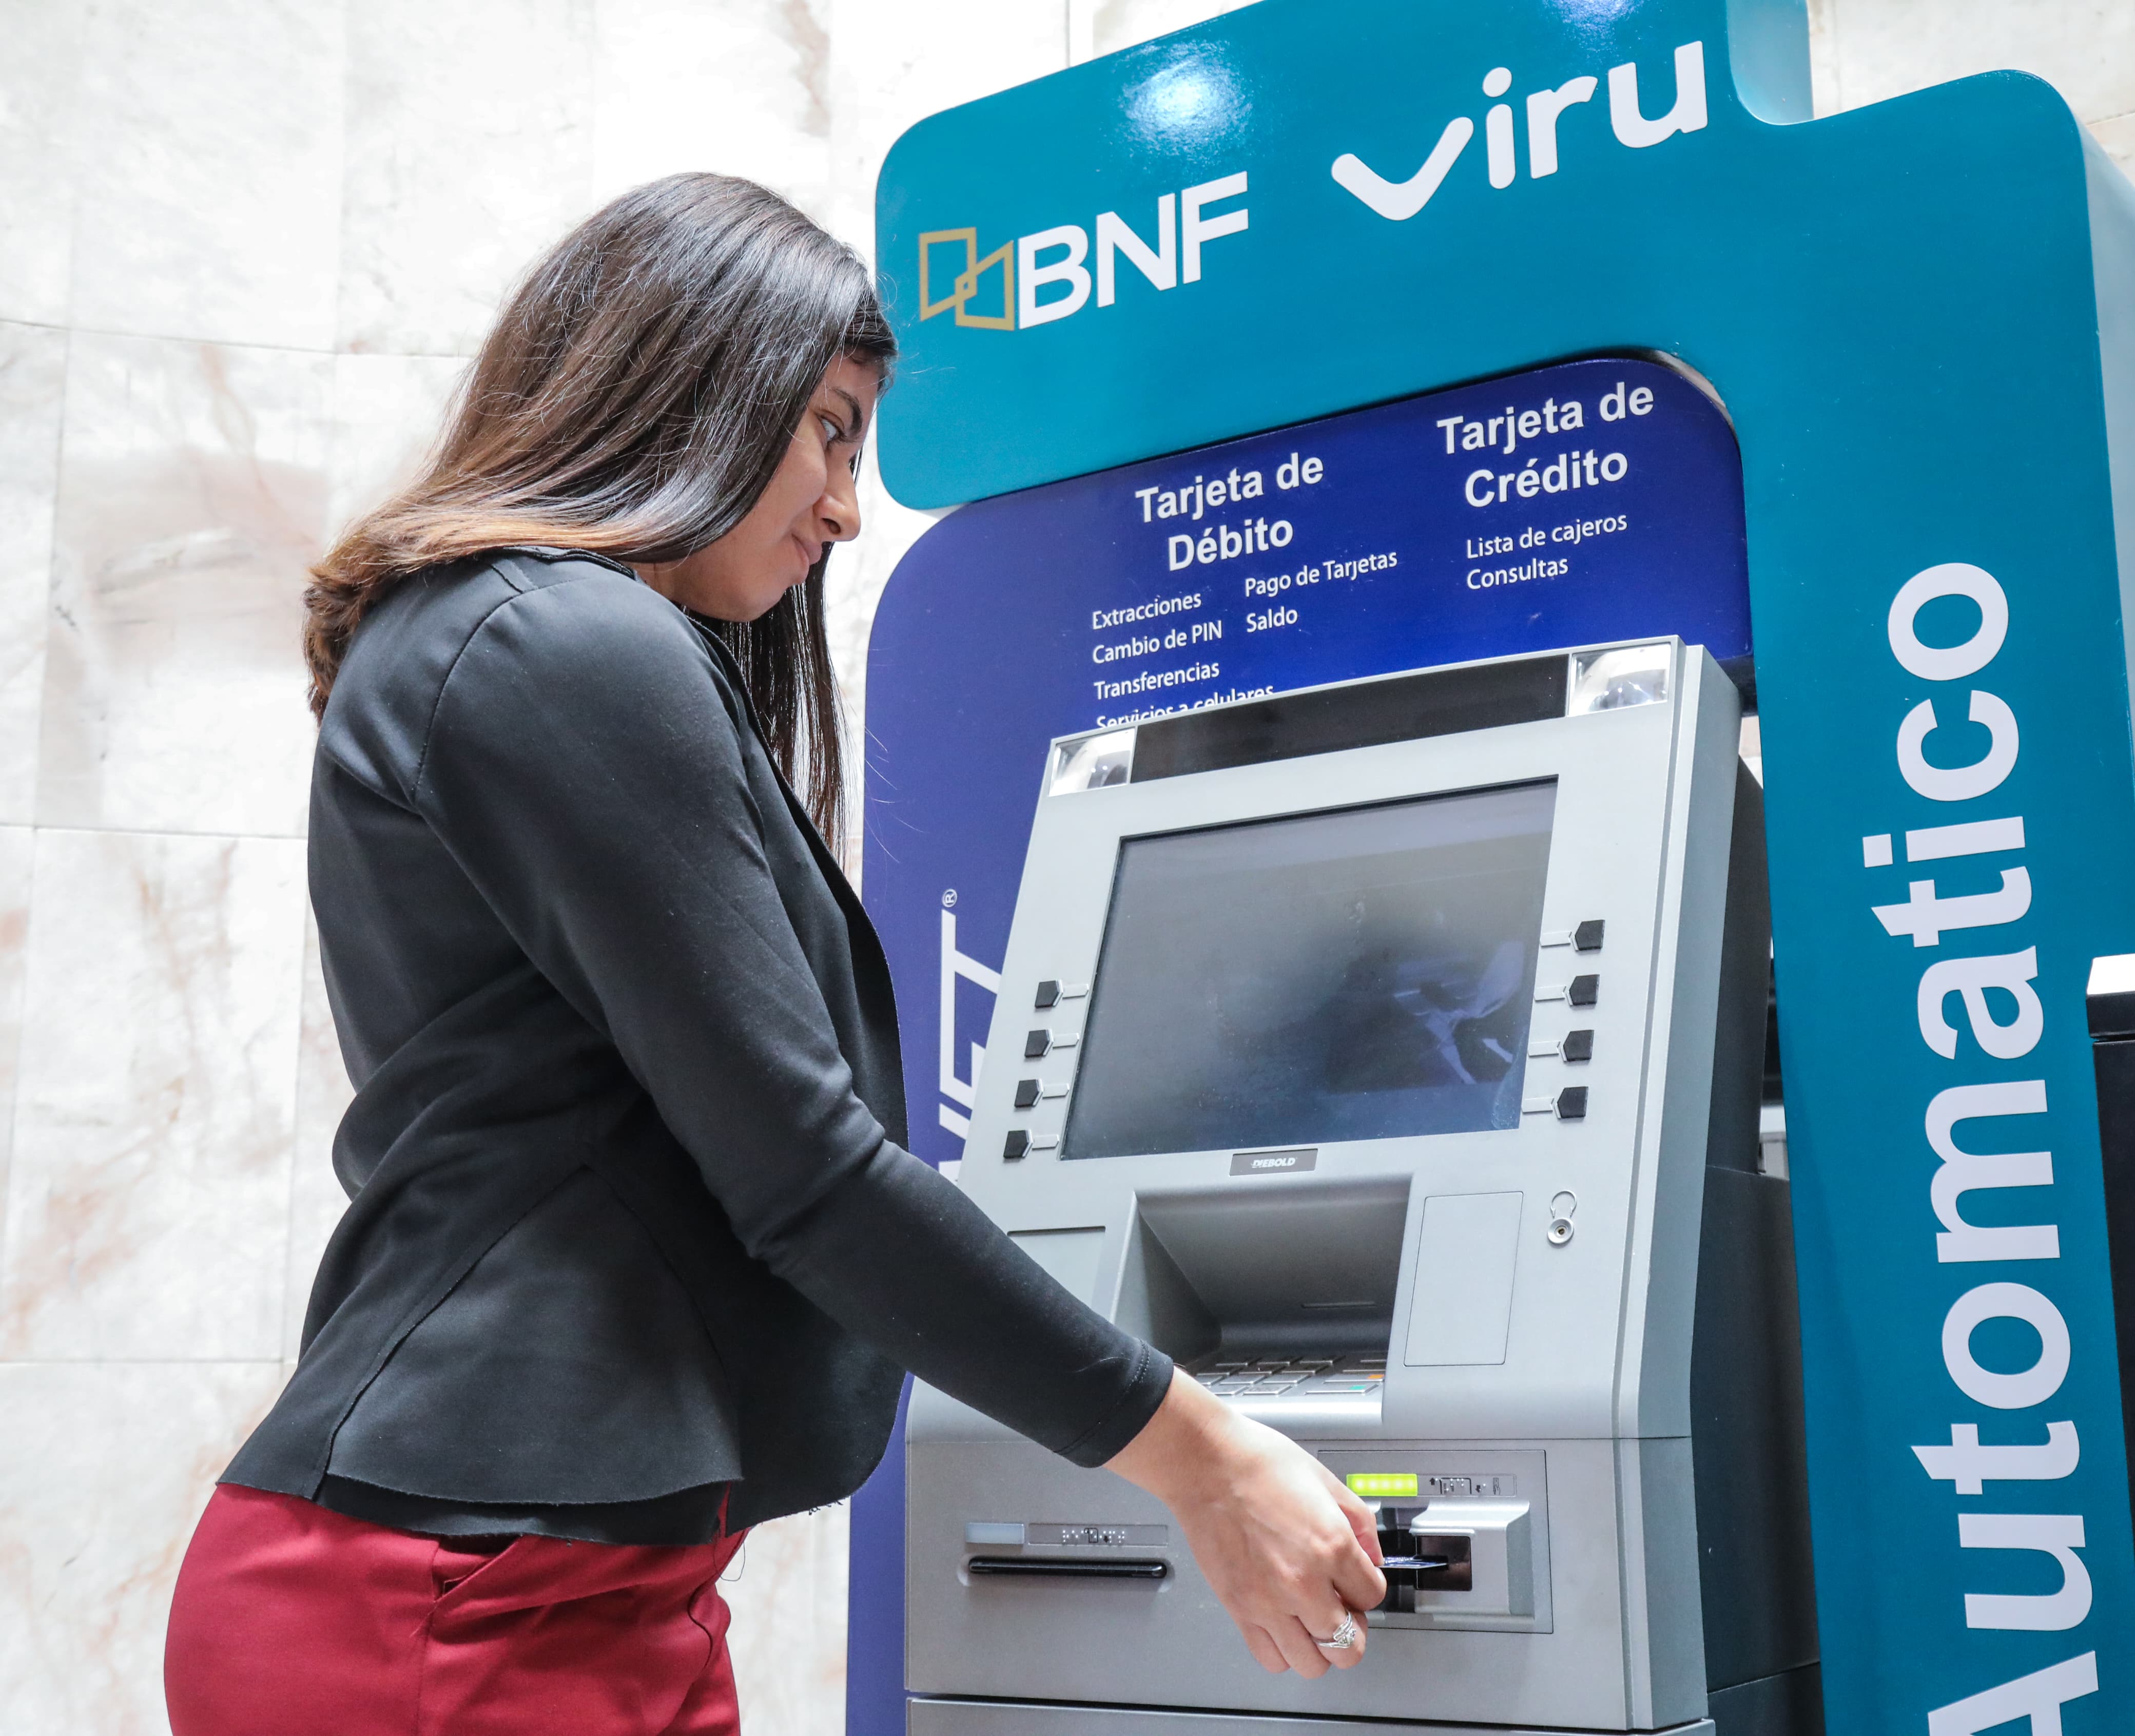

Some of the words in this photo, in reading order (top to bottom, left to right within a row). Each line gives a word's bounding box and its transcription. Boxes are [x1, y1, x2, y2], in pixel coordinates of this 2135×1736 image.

[1331, 40, 1708, 221] viru
[1018, 171, 1249, 330] BNF
[1437, 397, 1584, 454] Tarjeta
[1600, 381, 1654, 421] de
[1135, 468, 1264, 523] Tarjeta
[1276, 452, 1324, 490] de
[1464, 449, 1628, 507] Crédito
[1168, 516, 1293, 571] Débito
[1467, 536, 1513, 559] Lista
[1519, 527, 1546, 549] de
[1551, 515, 1627, 545] cajeros
[1245, 574, 1291, 597] Pago
[1295, 565, 1320, 586] de
[1323, 551, 1398, 581] Tarjetas
[1467, 558, 1568, 590] Consultas
[1092, 592, 1201, 630] Extracciones
[1246, 606, 1298, 633] Saldo
[1092, 629, 1160, 664] Cambio
[1164, 629, 1187, 649] de
[1192, 620, 1222, 644] PIN
[1093, 662, 1220, 700] Transferencias
[1250, 1157, 1296, 1168] DIEBOLD
[1862, 563, 2099, 1736] Automatico
